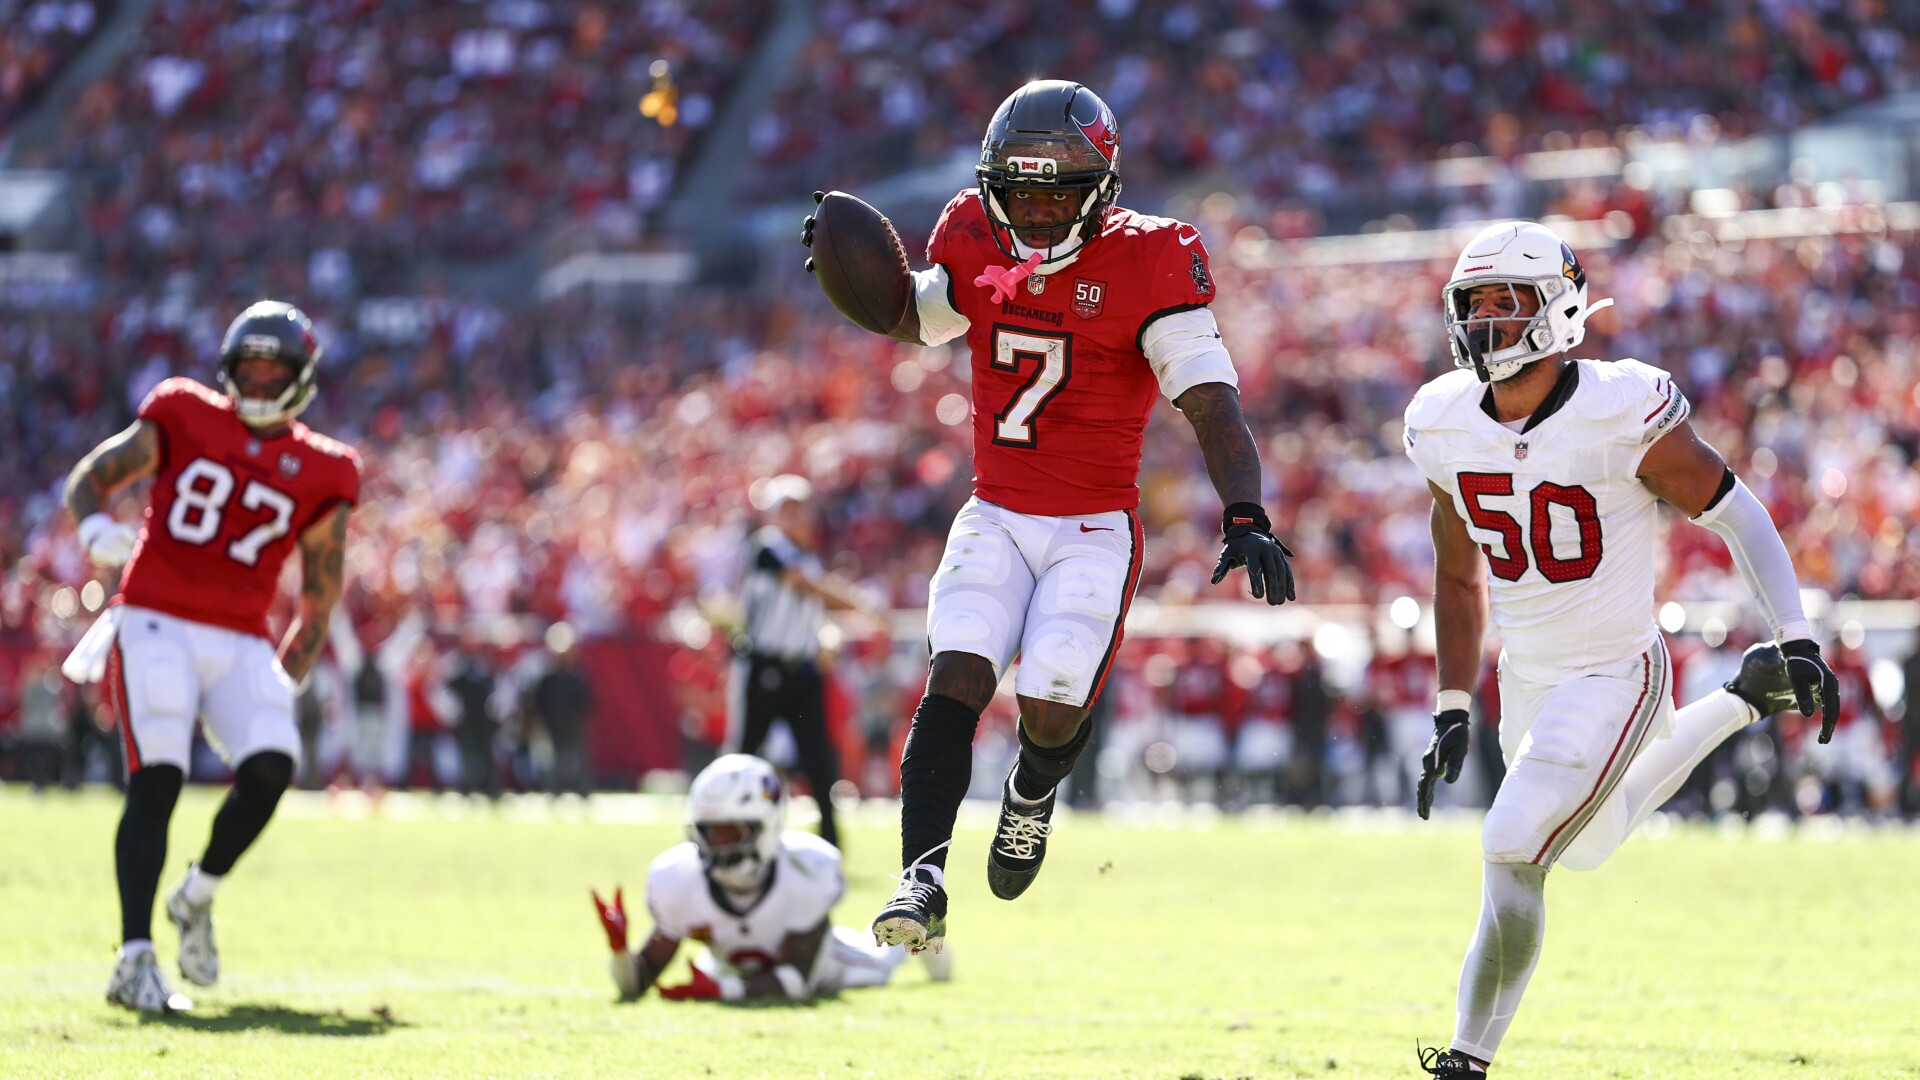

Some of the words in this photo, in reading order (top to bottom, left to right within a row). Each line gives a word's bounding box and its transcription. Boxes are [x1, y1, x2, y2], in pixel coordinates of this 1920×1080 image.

[1022, 161, 1038, 170] BUCS
[1002, 301, 1064, 326] BUCCANEERS
[1076, 283, 1101, 303] 50
[991, 322, 1073, 448] 7
[166, 455, 296, 569] 87
[1456, 471, 1603, 584] 50
